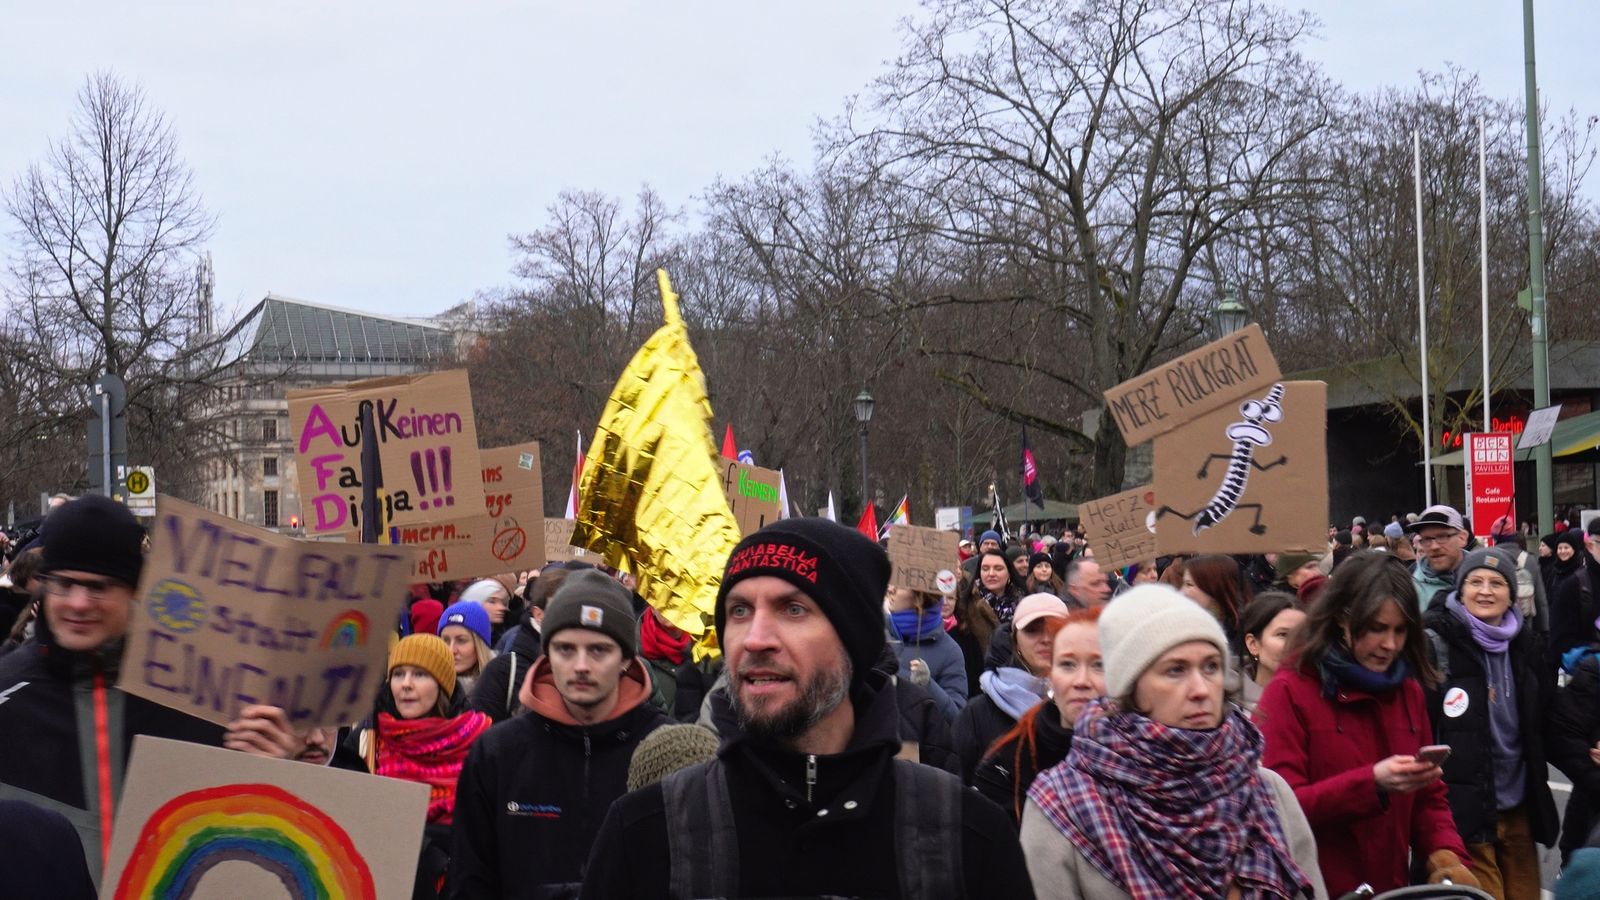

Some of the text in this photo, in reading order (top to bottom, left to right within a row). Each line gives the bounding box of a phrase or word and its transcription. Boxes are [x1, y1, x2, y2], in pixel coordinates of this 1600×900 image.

[1166, 335, 1259, 408] RÜCKGRAT
[377, 398, 462, 443] Keinen
[310, 453, 368, 491] Fa
[1474, 465, 1510, 473] PAVILLON
[311, 489, 413, 532] Dia
[1087, 495, 1144, 526] Herz
[1475, 496, 1511, 504] Restaurant
[164, 514, 402, 600] VIELFALT
